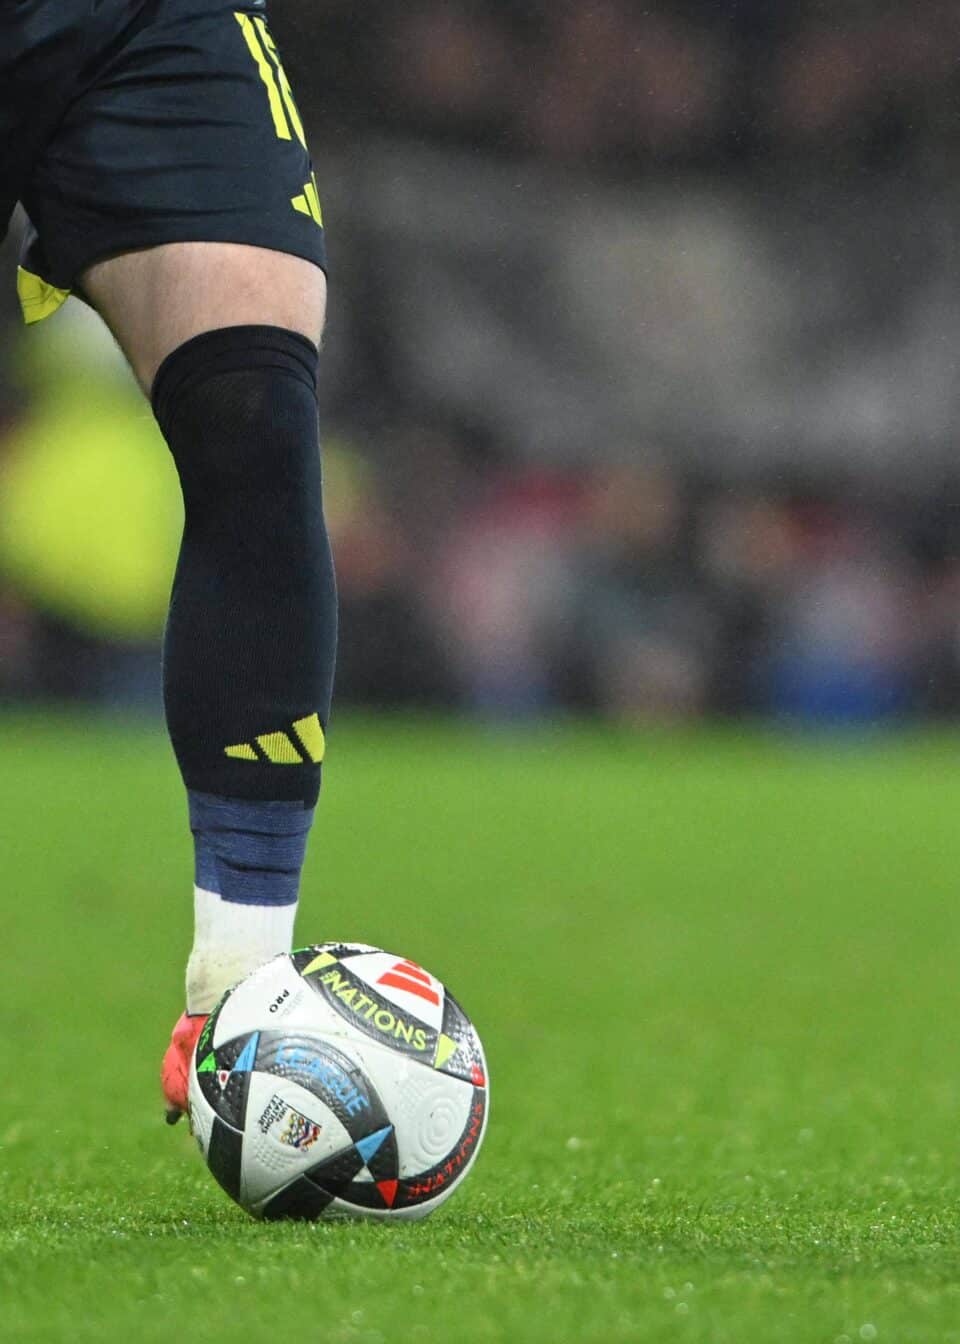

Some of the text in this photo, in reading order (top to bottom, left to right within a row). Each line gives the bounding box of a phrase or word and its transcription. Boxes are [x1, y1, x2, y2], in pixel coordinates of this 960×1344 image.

[269, 989, 290, 1013] PRO
[325, 971, 427, 1052] NATIONS
[275, 1043, 369, 1117] LEAGUE
